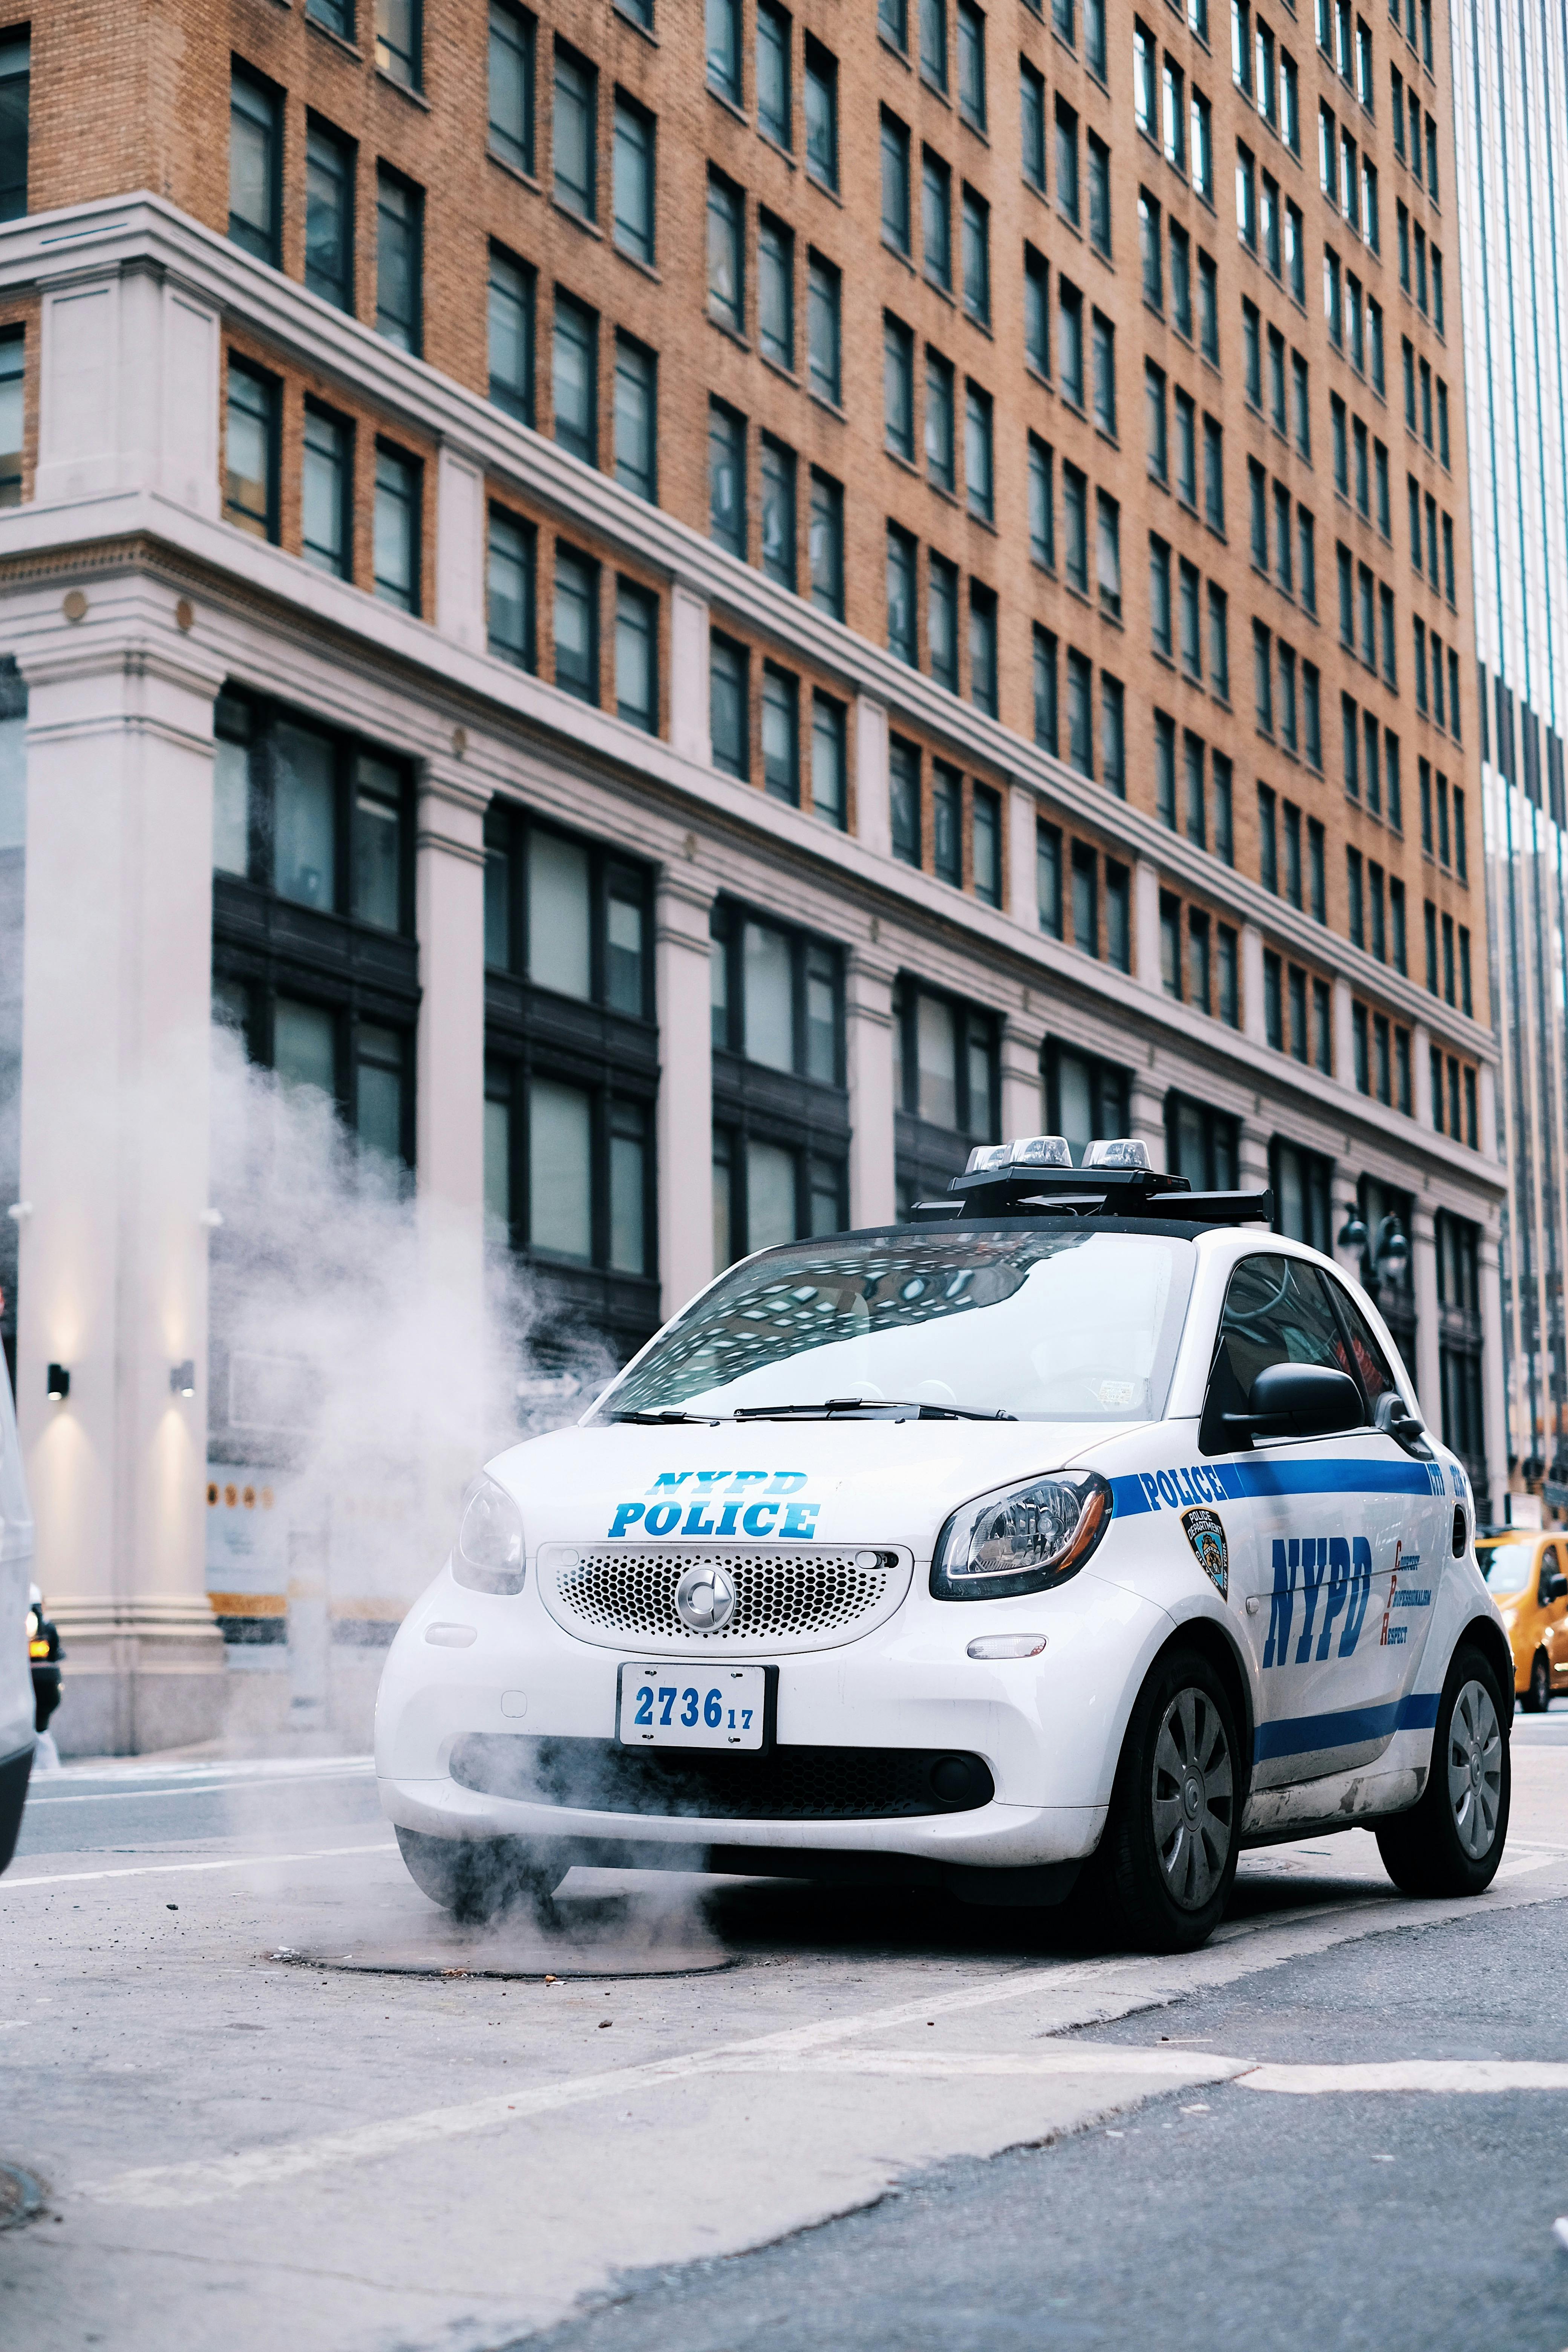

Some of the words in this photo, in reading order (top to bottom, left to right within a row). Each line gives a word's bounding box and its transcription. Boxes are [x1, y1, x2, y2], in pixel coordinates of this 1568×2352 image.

[644, 1471, 808, 1495] NYPD
[1140, 1466, 1228, 1510] POLICE
[608, 1501, 821, 1539] POLICE
[1187, 1521, 1223, 1540] DEPARTMENT
[1188, 1510, 1212, 1524] POLICE
[1195, 1550, 1211, 1573] CITY
[1211, 1576, 1219, 1586] OF
[1263, 1536, 1372, 1668] NYPD
[1380, 1612, 1408, 1646] RESPECT
[635, 1686, 722, 1728] 2736
[727, 1709, 753, 1729] 17
